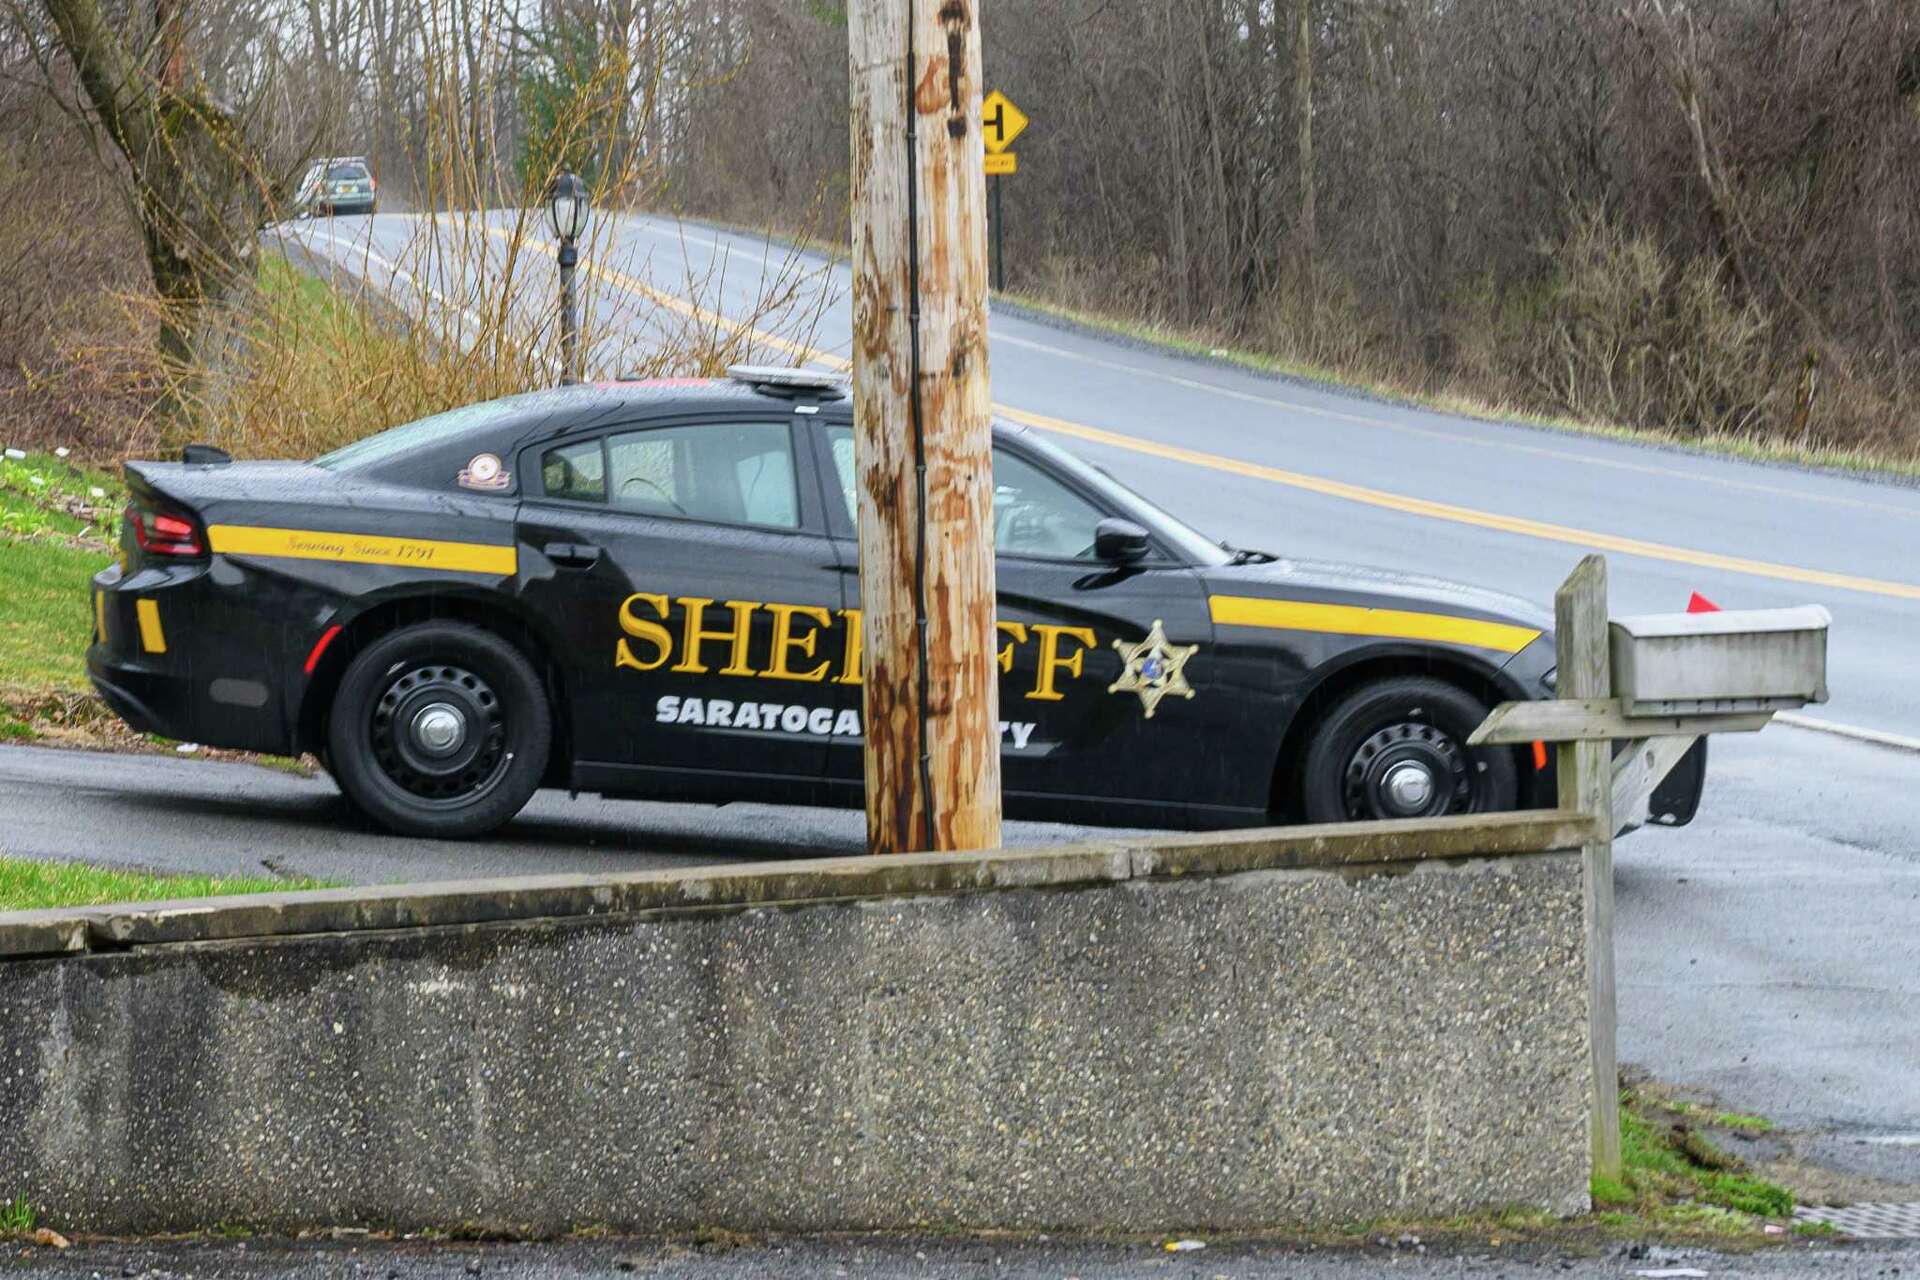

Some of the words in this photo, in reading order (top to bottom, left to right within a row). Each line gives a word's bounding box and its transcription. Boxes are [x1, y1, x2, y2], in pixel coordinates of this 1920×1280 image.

[287, 535, 345, 556] Serving
[351, 540, 391, 556] Since
[395, 544, 436, 561] 1791
[615, 592, 1098, 701] SHEF
[655, 695, 862, 736] SARATOGA
